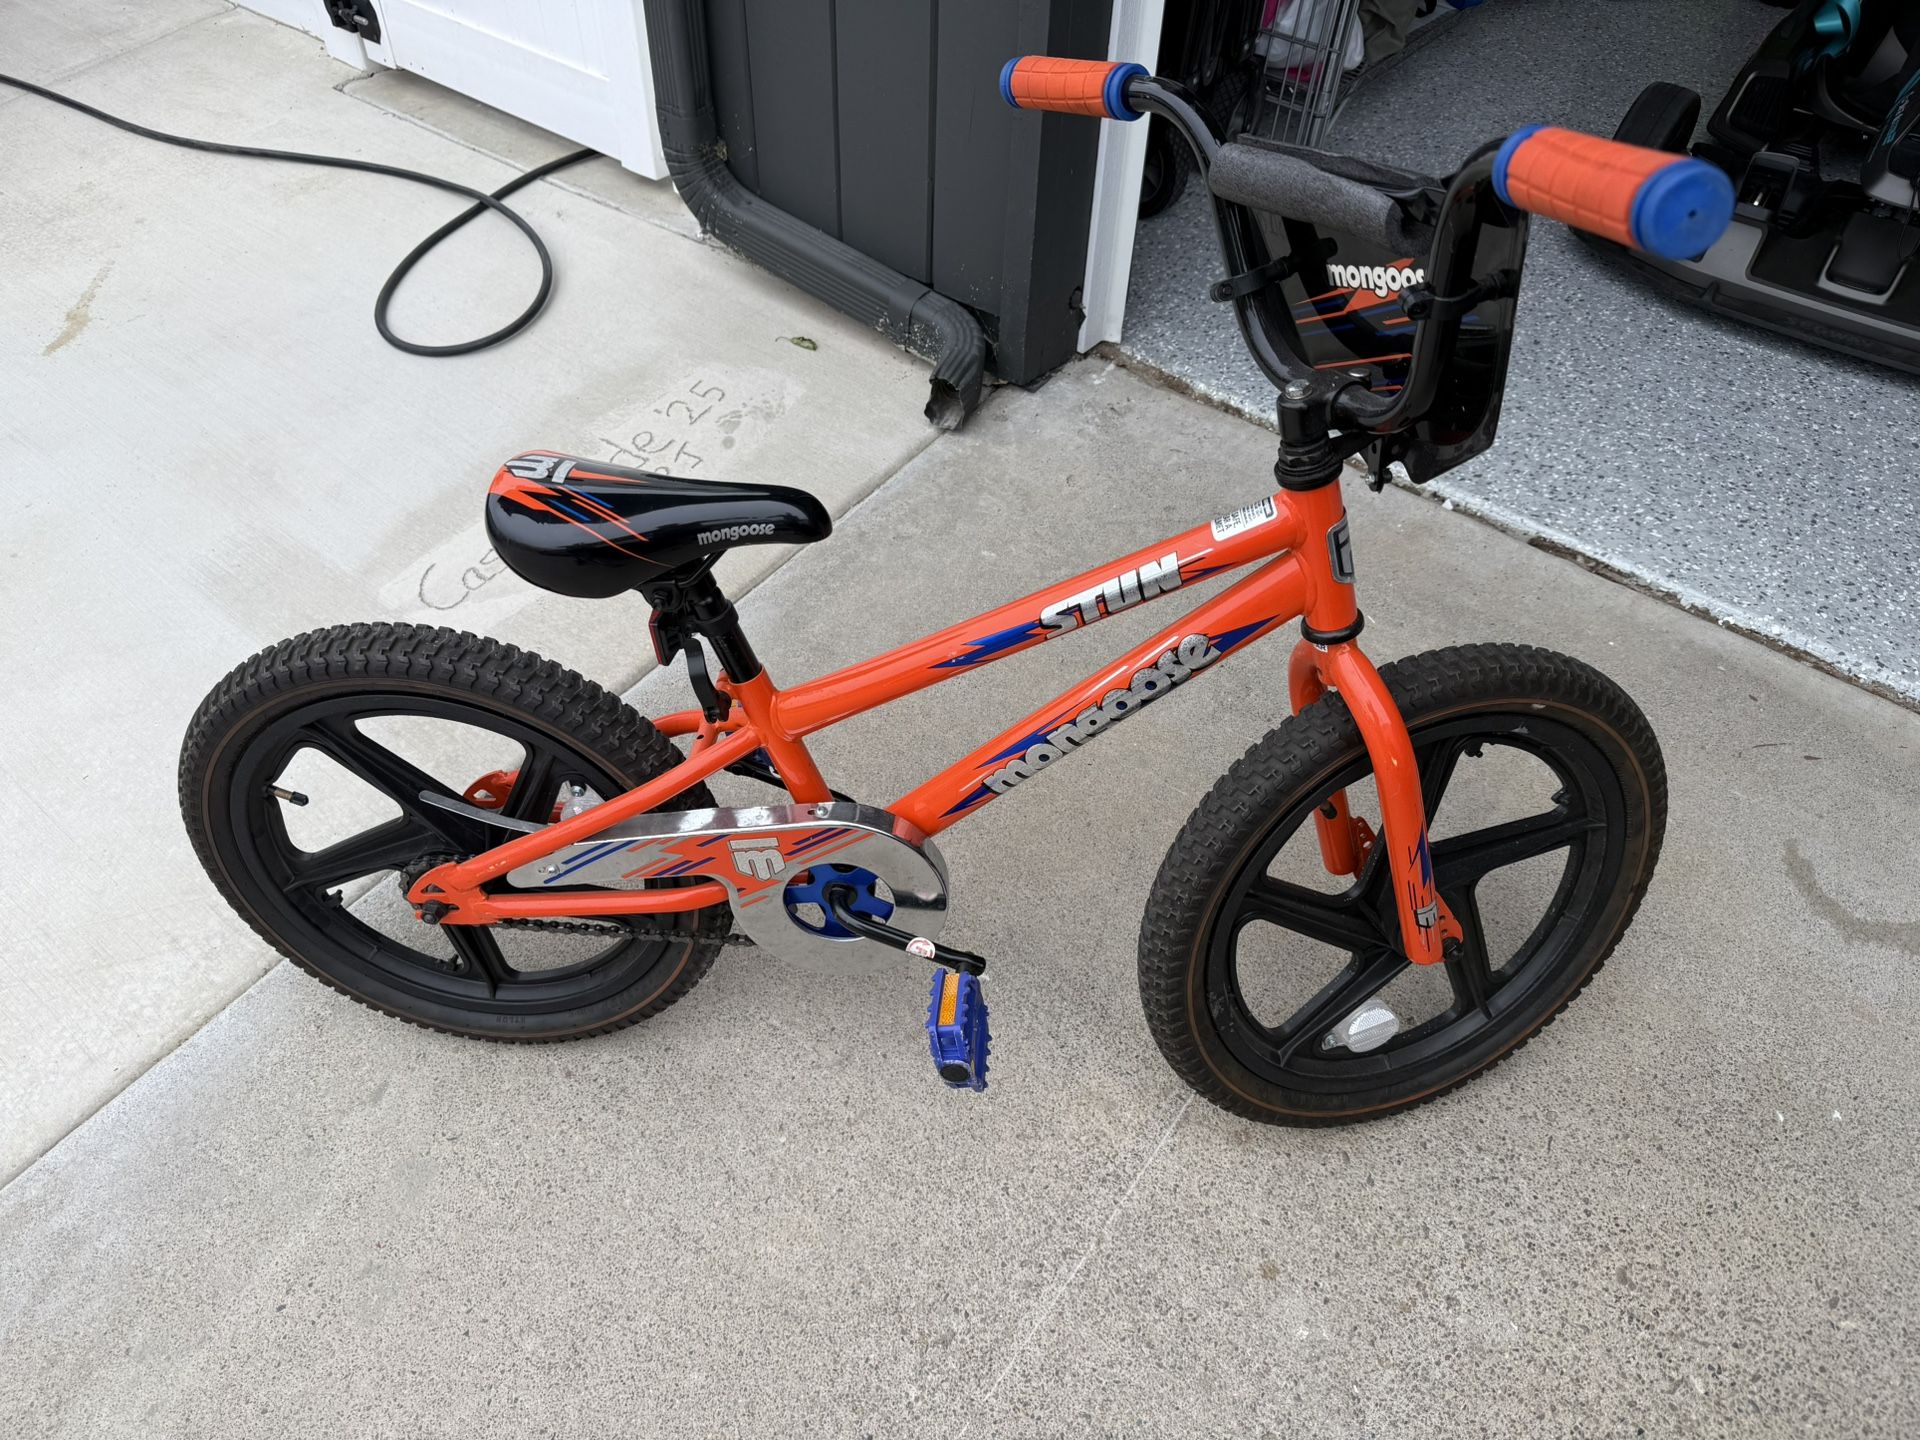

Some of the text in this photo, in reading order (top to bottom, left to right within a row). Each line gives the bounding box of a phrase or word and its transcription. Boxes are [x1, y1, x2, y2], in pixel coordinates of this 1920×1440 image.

[1326, 264, 1425, 298] mongoos
[697, 523, 776, 545] mongoose
[418, 548, 508, 610] Cas
[1039, 551, 1183, 640] STUN
[982, 633, 1223, 795] mongoose
